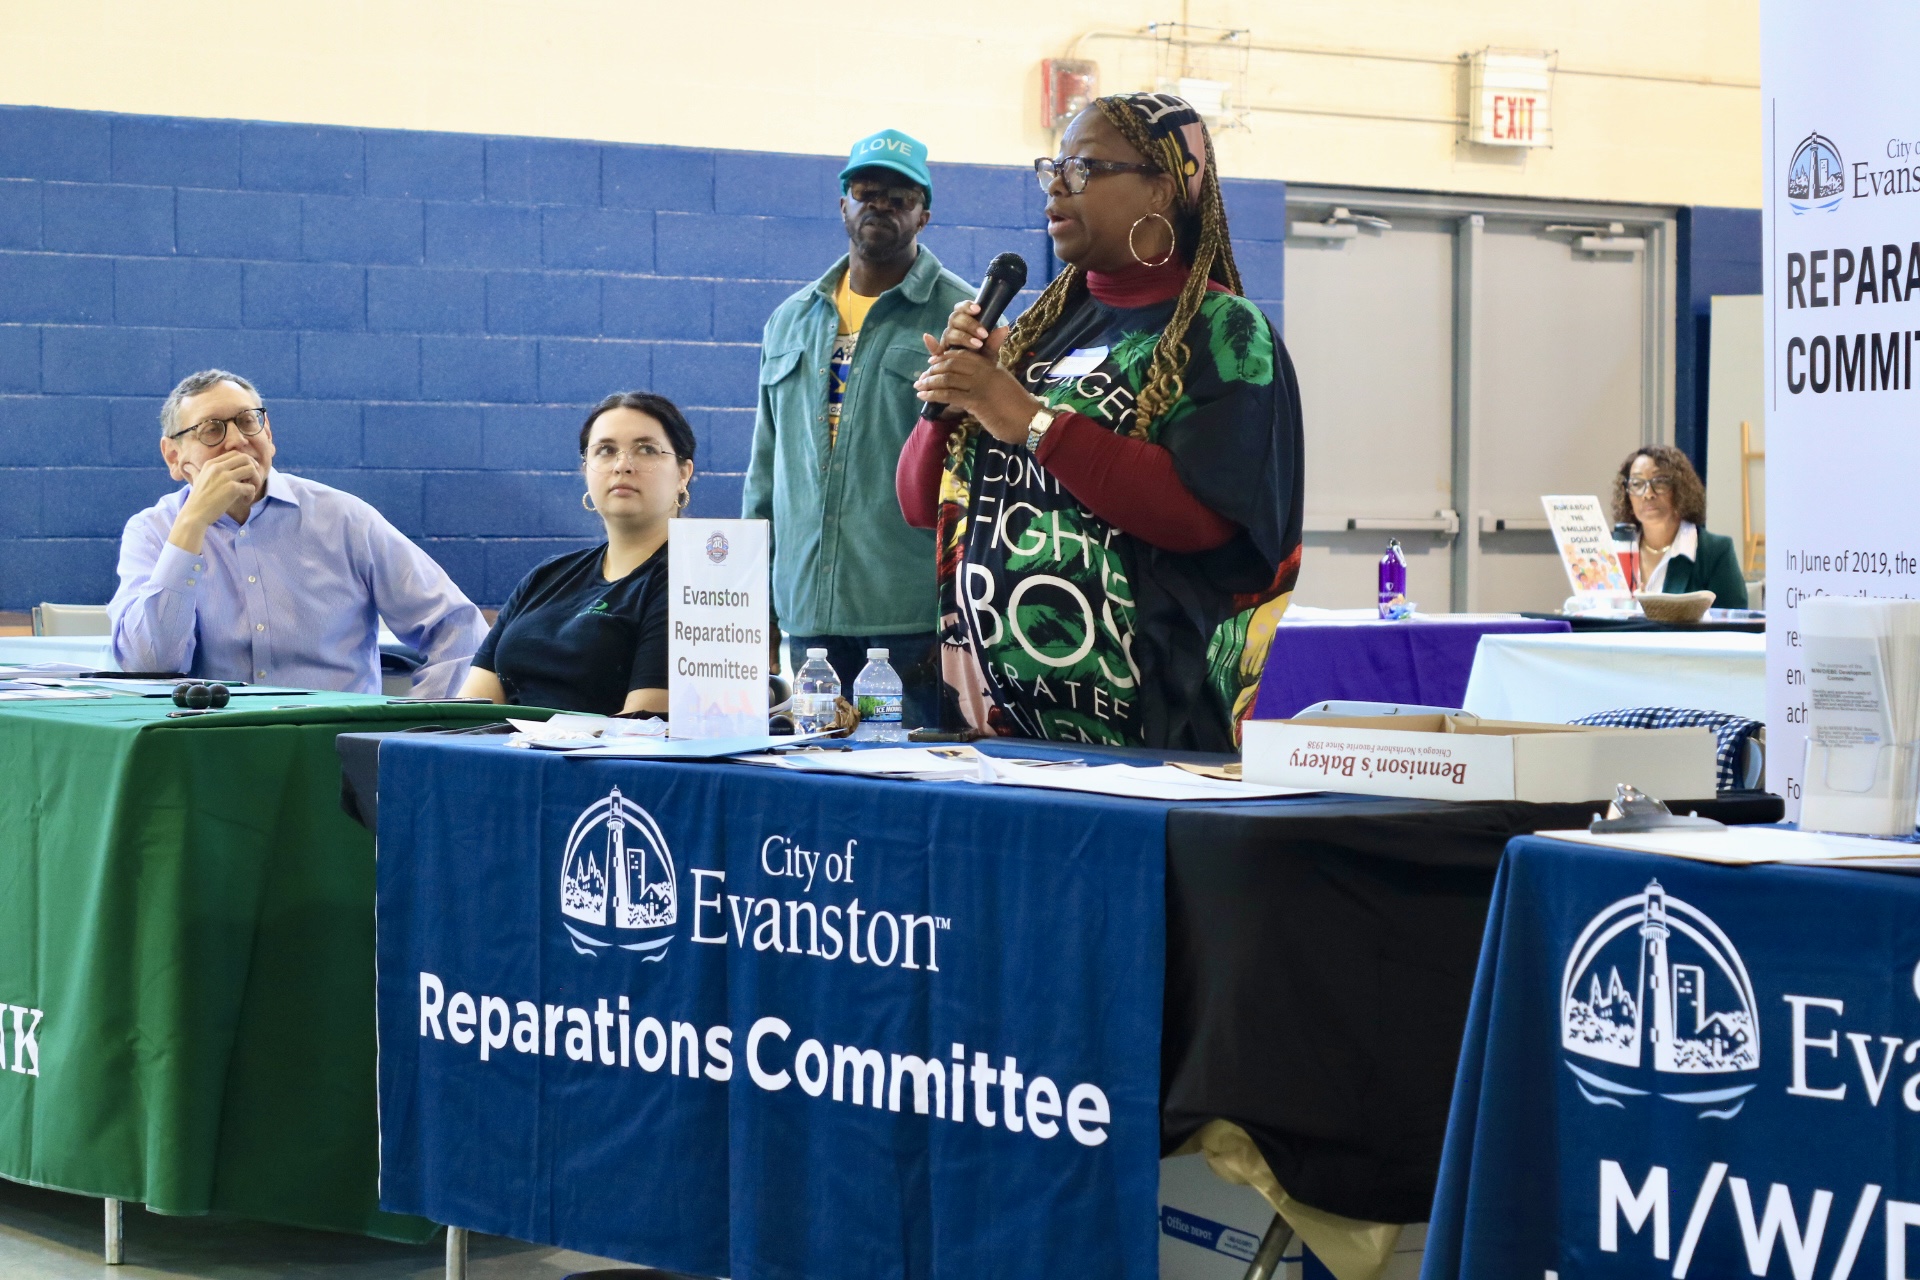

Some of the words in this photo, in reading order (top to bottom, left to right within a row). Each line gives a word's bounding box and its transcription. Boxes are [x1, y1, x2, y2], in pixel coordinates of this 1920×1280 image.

[1494, 96, 1536, 140] EXIT
[859, 138, 913, 157] LOVE
[1886, 138, 1911, 163] City
[1786, 549, 1797, 571] In
[1800, 549, 1831, 574] June
[1835, 549, 1849, 572] of
[1852, 551, 1892, 577] 2019,
[1896, 550, 1917, 574] the
[683, 585, 749, 607] Evanston
[675, 620, 762, 646] Reparations
[677, 656, 758, 680] Committee
[1307, 740, 1324, 749] 1938
[1326, 742, 1345, 751] Since
[1346, 743, 1375, 753] Favorite
[1376, 745, 1416, 755] Northshore
[1418, 746, 1452, 758] Chicago's
[1289, 748, 1357, 777] Bakery
[1361, 757, 1467, 785] Bennison's
[761, 835, 820, 892] City
[825, 839, 858, 883] of
[419, 971, 733, 1082] Reparations
[746, 1015, 1112, 1147] Committee
[1166, 1215, 1190, 1233] Office
[1191, 1226, 1213, 1241] DEPOT
